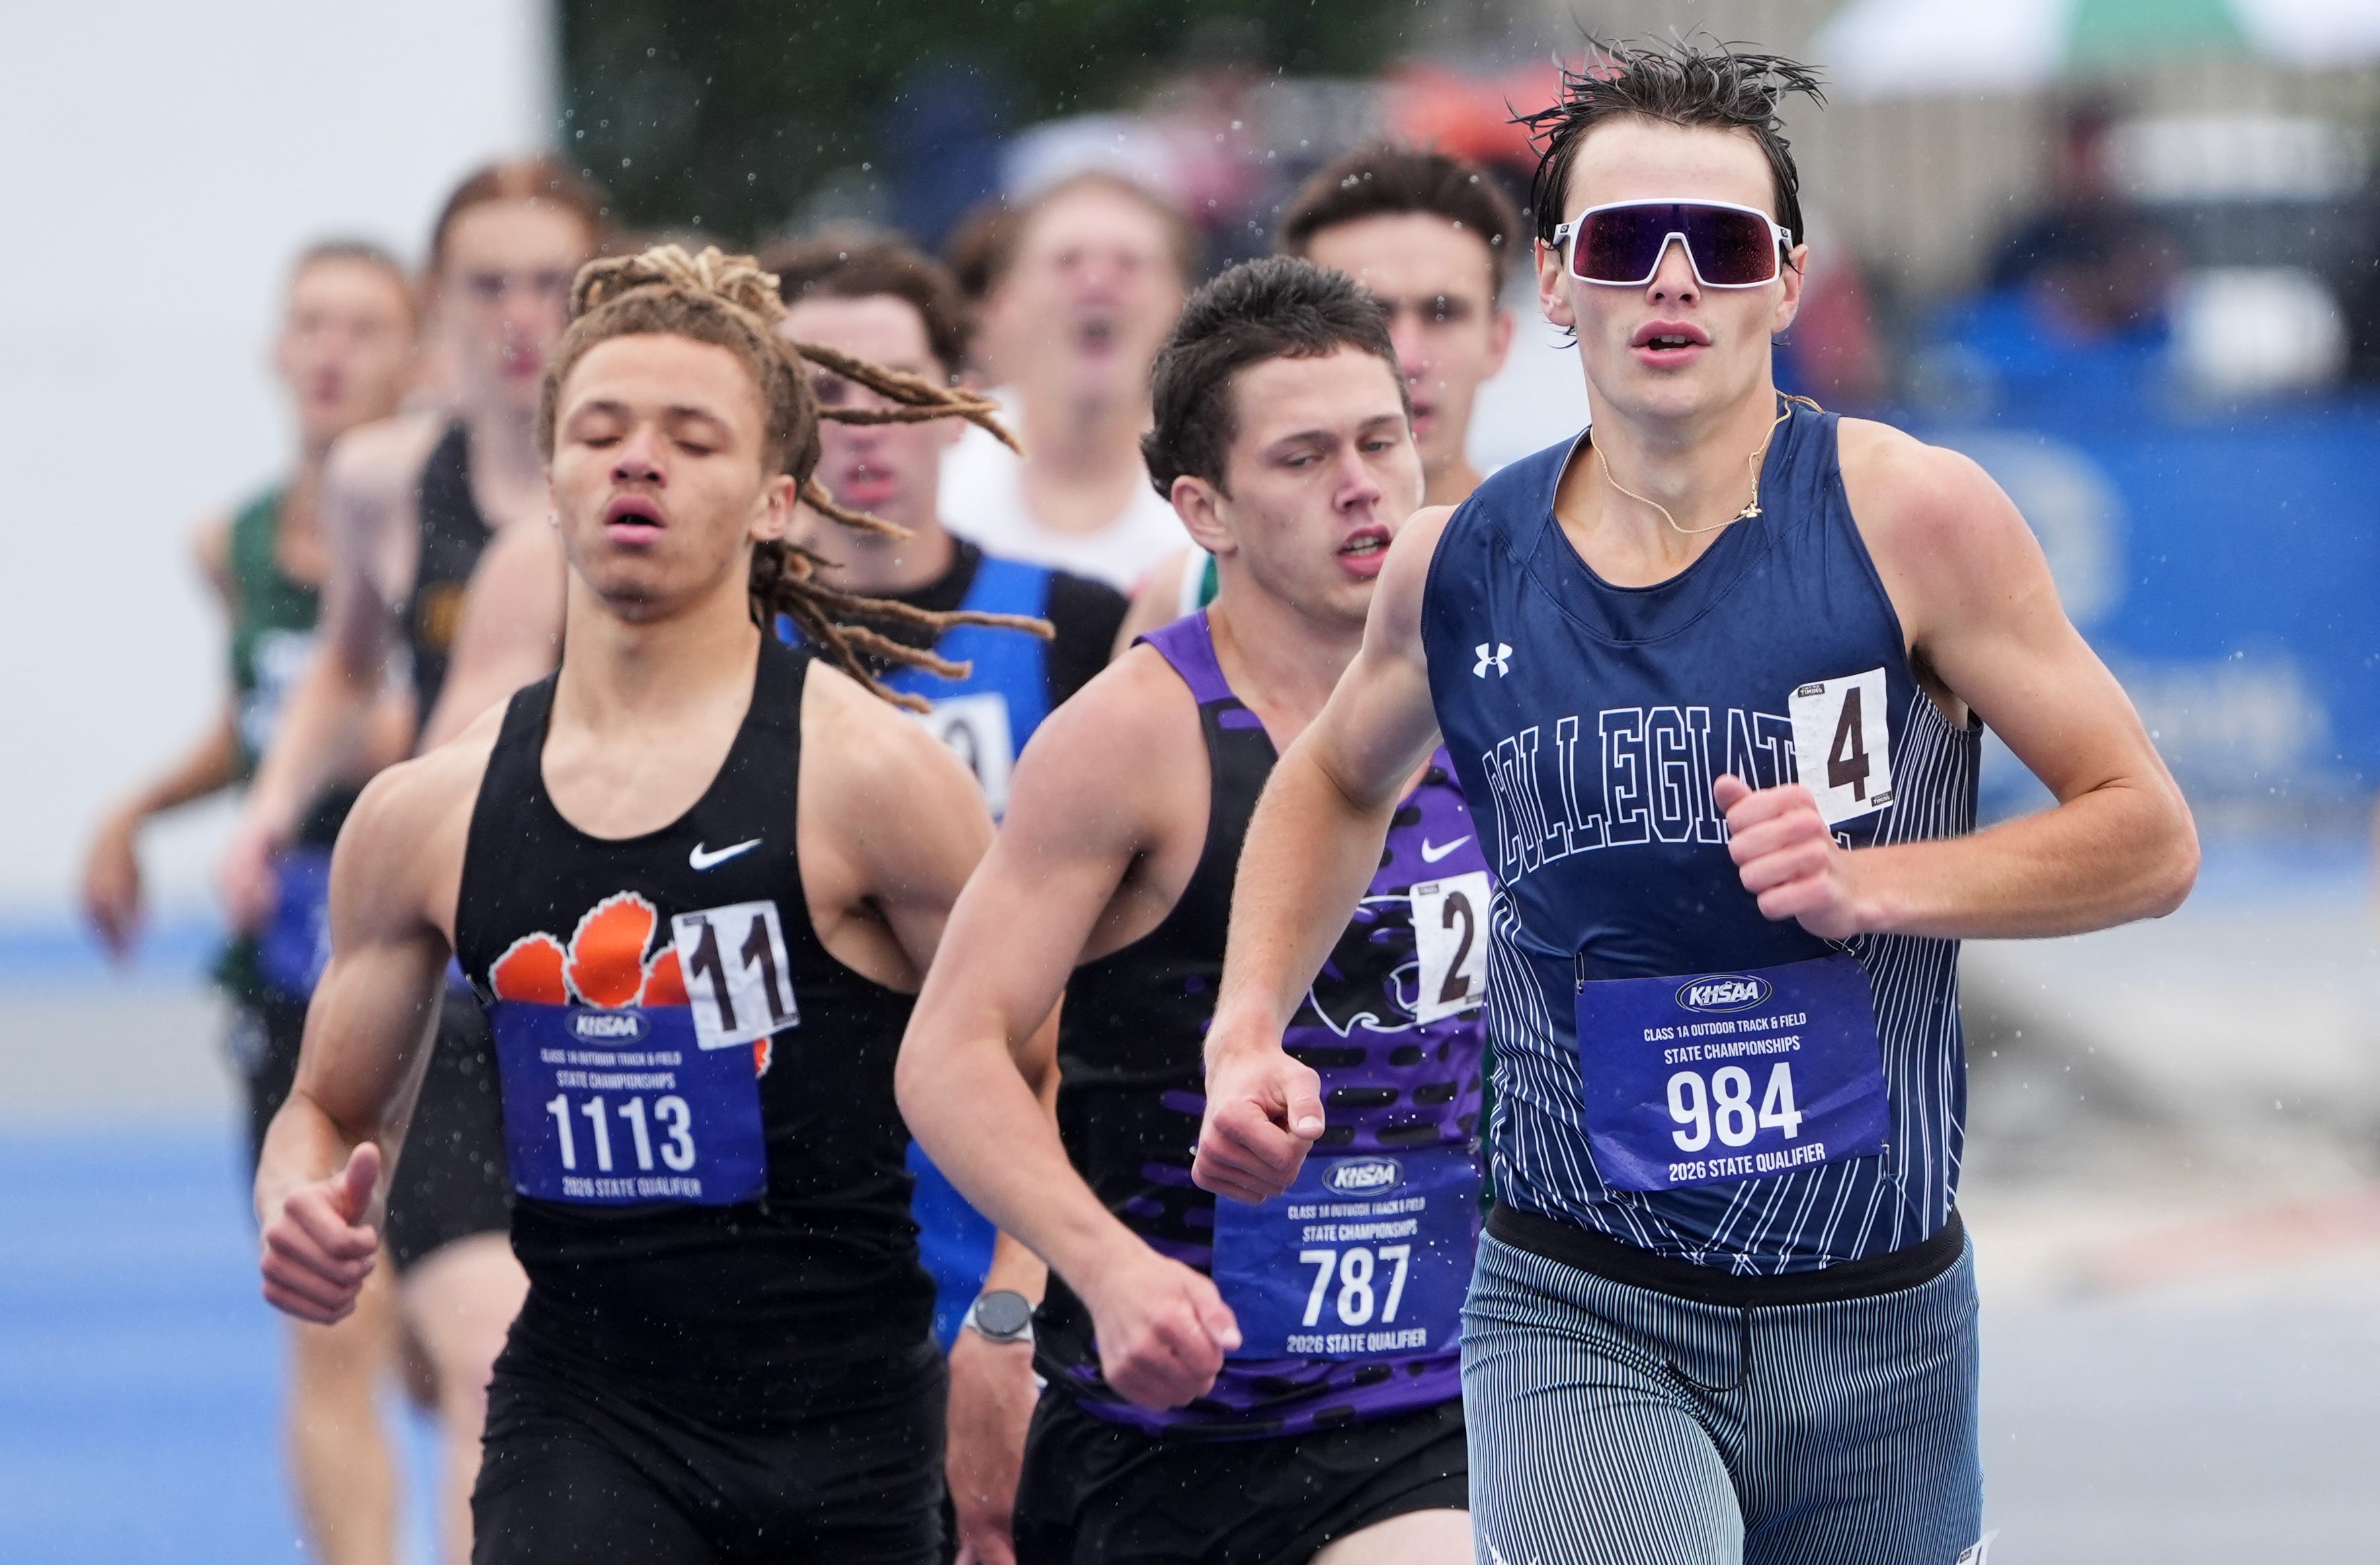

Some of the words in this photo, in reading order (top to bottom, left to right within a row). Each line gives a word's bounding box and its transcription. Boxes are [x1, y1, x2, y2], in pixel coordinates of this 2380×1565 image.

[1828, 687, 1871, 803] 4
[1481, 706, 1852, 887] COLLEGIAT
[1439, 891, 1474, 1004] 2
[690, 914, 784, 1032] 11
[1689, 981, 1759, 1006] KHSAA
[1644, 1027, 1674, 1041] CLASS
[1677, 1025, 1690, 1038] 1A
[1691, 1021, 1735, 1036] OUTDOOR
[1737, 1017, 1769, 1033] TRACK
[1770, 1016, 1778, 1029] &
[1780, 1012, 1807, 1028] FIELD
[1664, 1045, 1702, 1065] STATE
[1704, 1035, 1801, 1059] CHAMPIONSHIPS
[556, 1070, 588, 1088] STATE
[589, 1072, 676, 1090] CHAMPIONSHIPS
[1667, 1061, 1803, 1152] 984
[546, 1094, 696, 1171] 1113
[1334, 1163, 1395, 1189] KHSAA
[1670, 1161, 1706, 1182] 2026
[1709, 1156, 1754, 1177] STATE
[1756, 1143, 1826, 1172] QUALIFIER
[595, 1178, 637, 1197] STATE
[638, 1177, 702, 1197] QUALIFIER
[1288, 1205, 1317, 1219] CLASS
[1372, 1200, 1399, 1215] TRACK
[1405, 1197, 1426, 1211] FIELD
[1303, 1225, 1338, 1242] STATE
[1338, 1218, 1418, 1241] CHAMPIONSHIPS
[1299, 1244, 1411, 1326] 787
[1286, 1334, 1323, 1353] 2026
[1326, 1333, 1366, 1353] STATE
[1367, 1328, 1427, 1352] QUALIFIER
